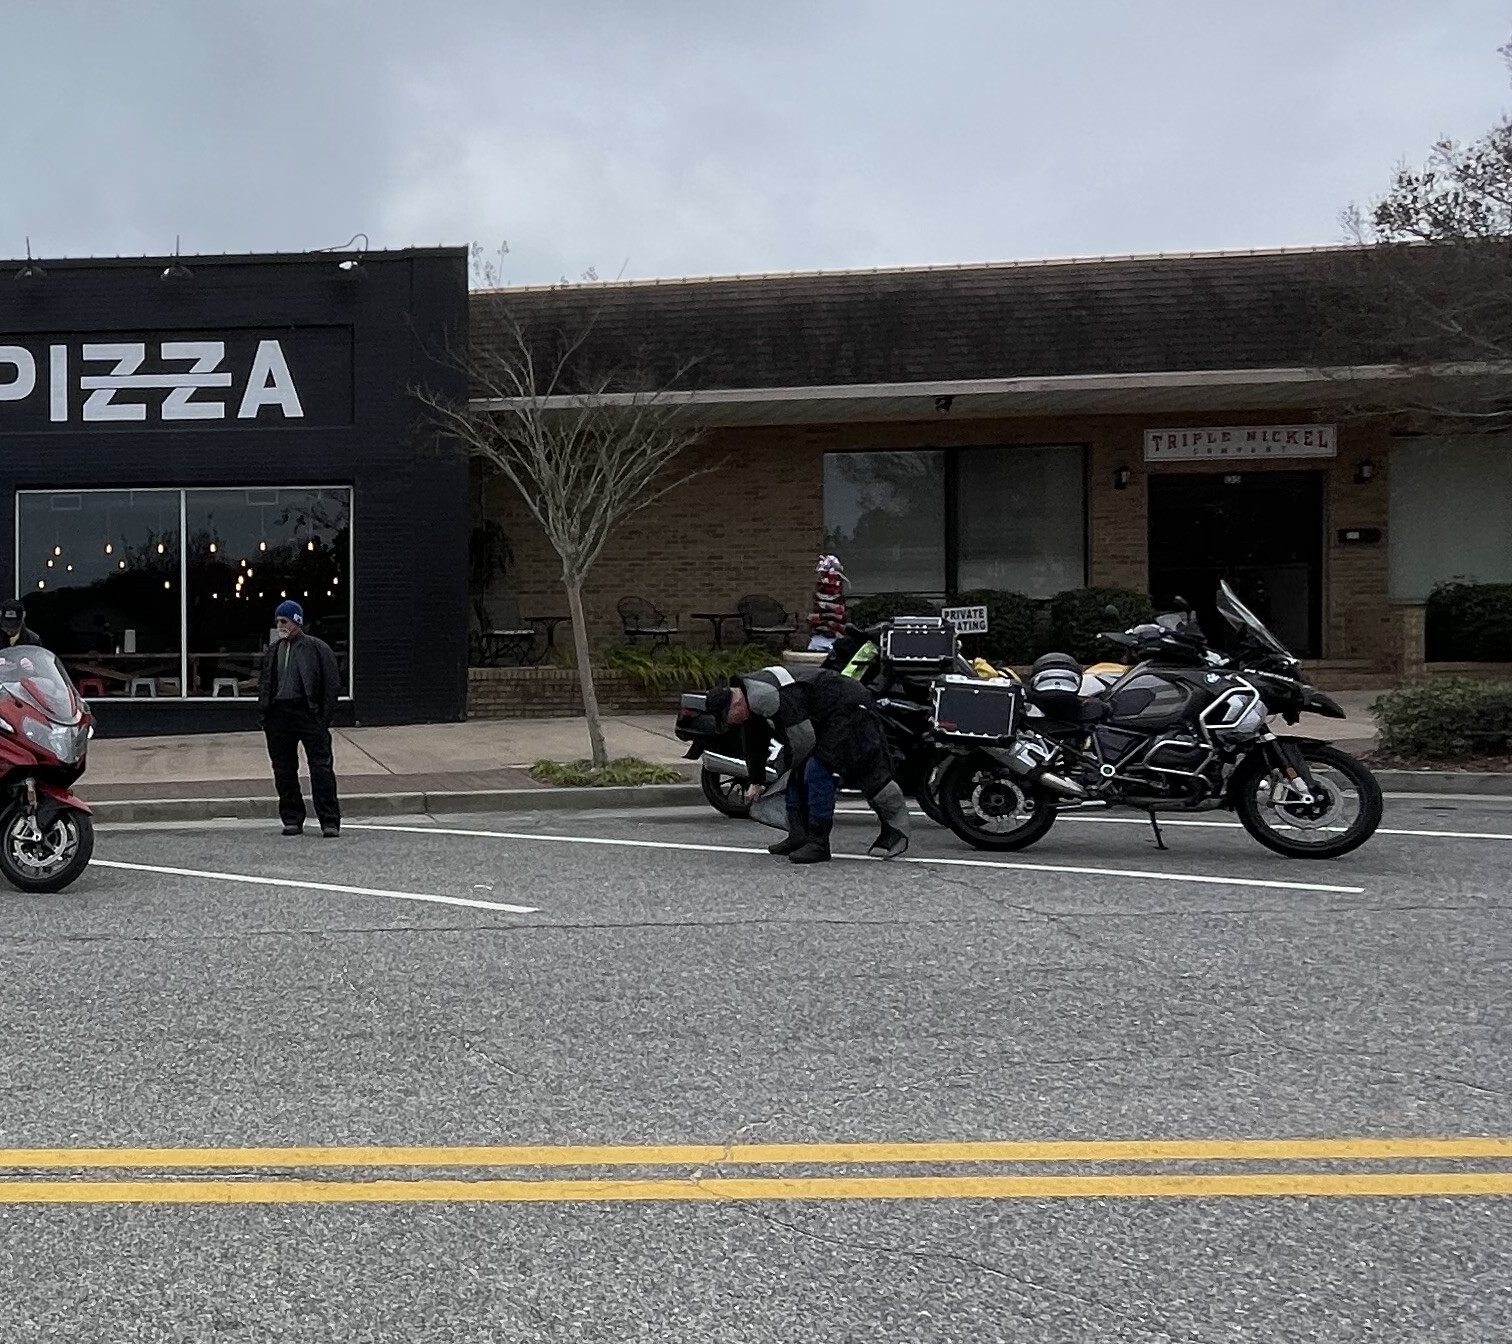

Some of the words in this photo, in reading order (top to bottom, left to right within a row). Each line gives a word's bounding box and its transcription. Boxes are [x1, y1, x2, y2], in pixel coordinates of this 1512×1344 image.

[1151, 432, 1232, 452] TRIPLE
[1246, 430, 1328, 449] NICKEL
[944, 608, 985, 620] PRIVATE
[956, 620, 986, 631] ATING
